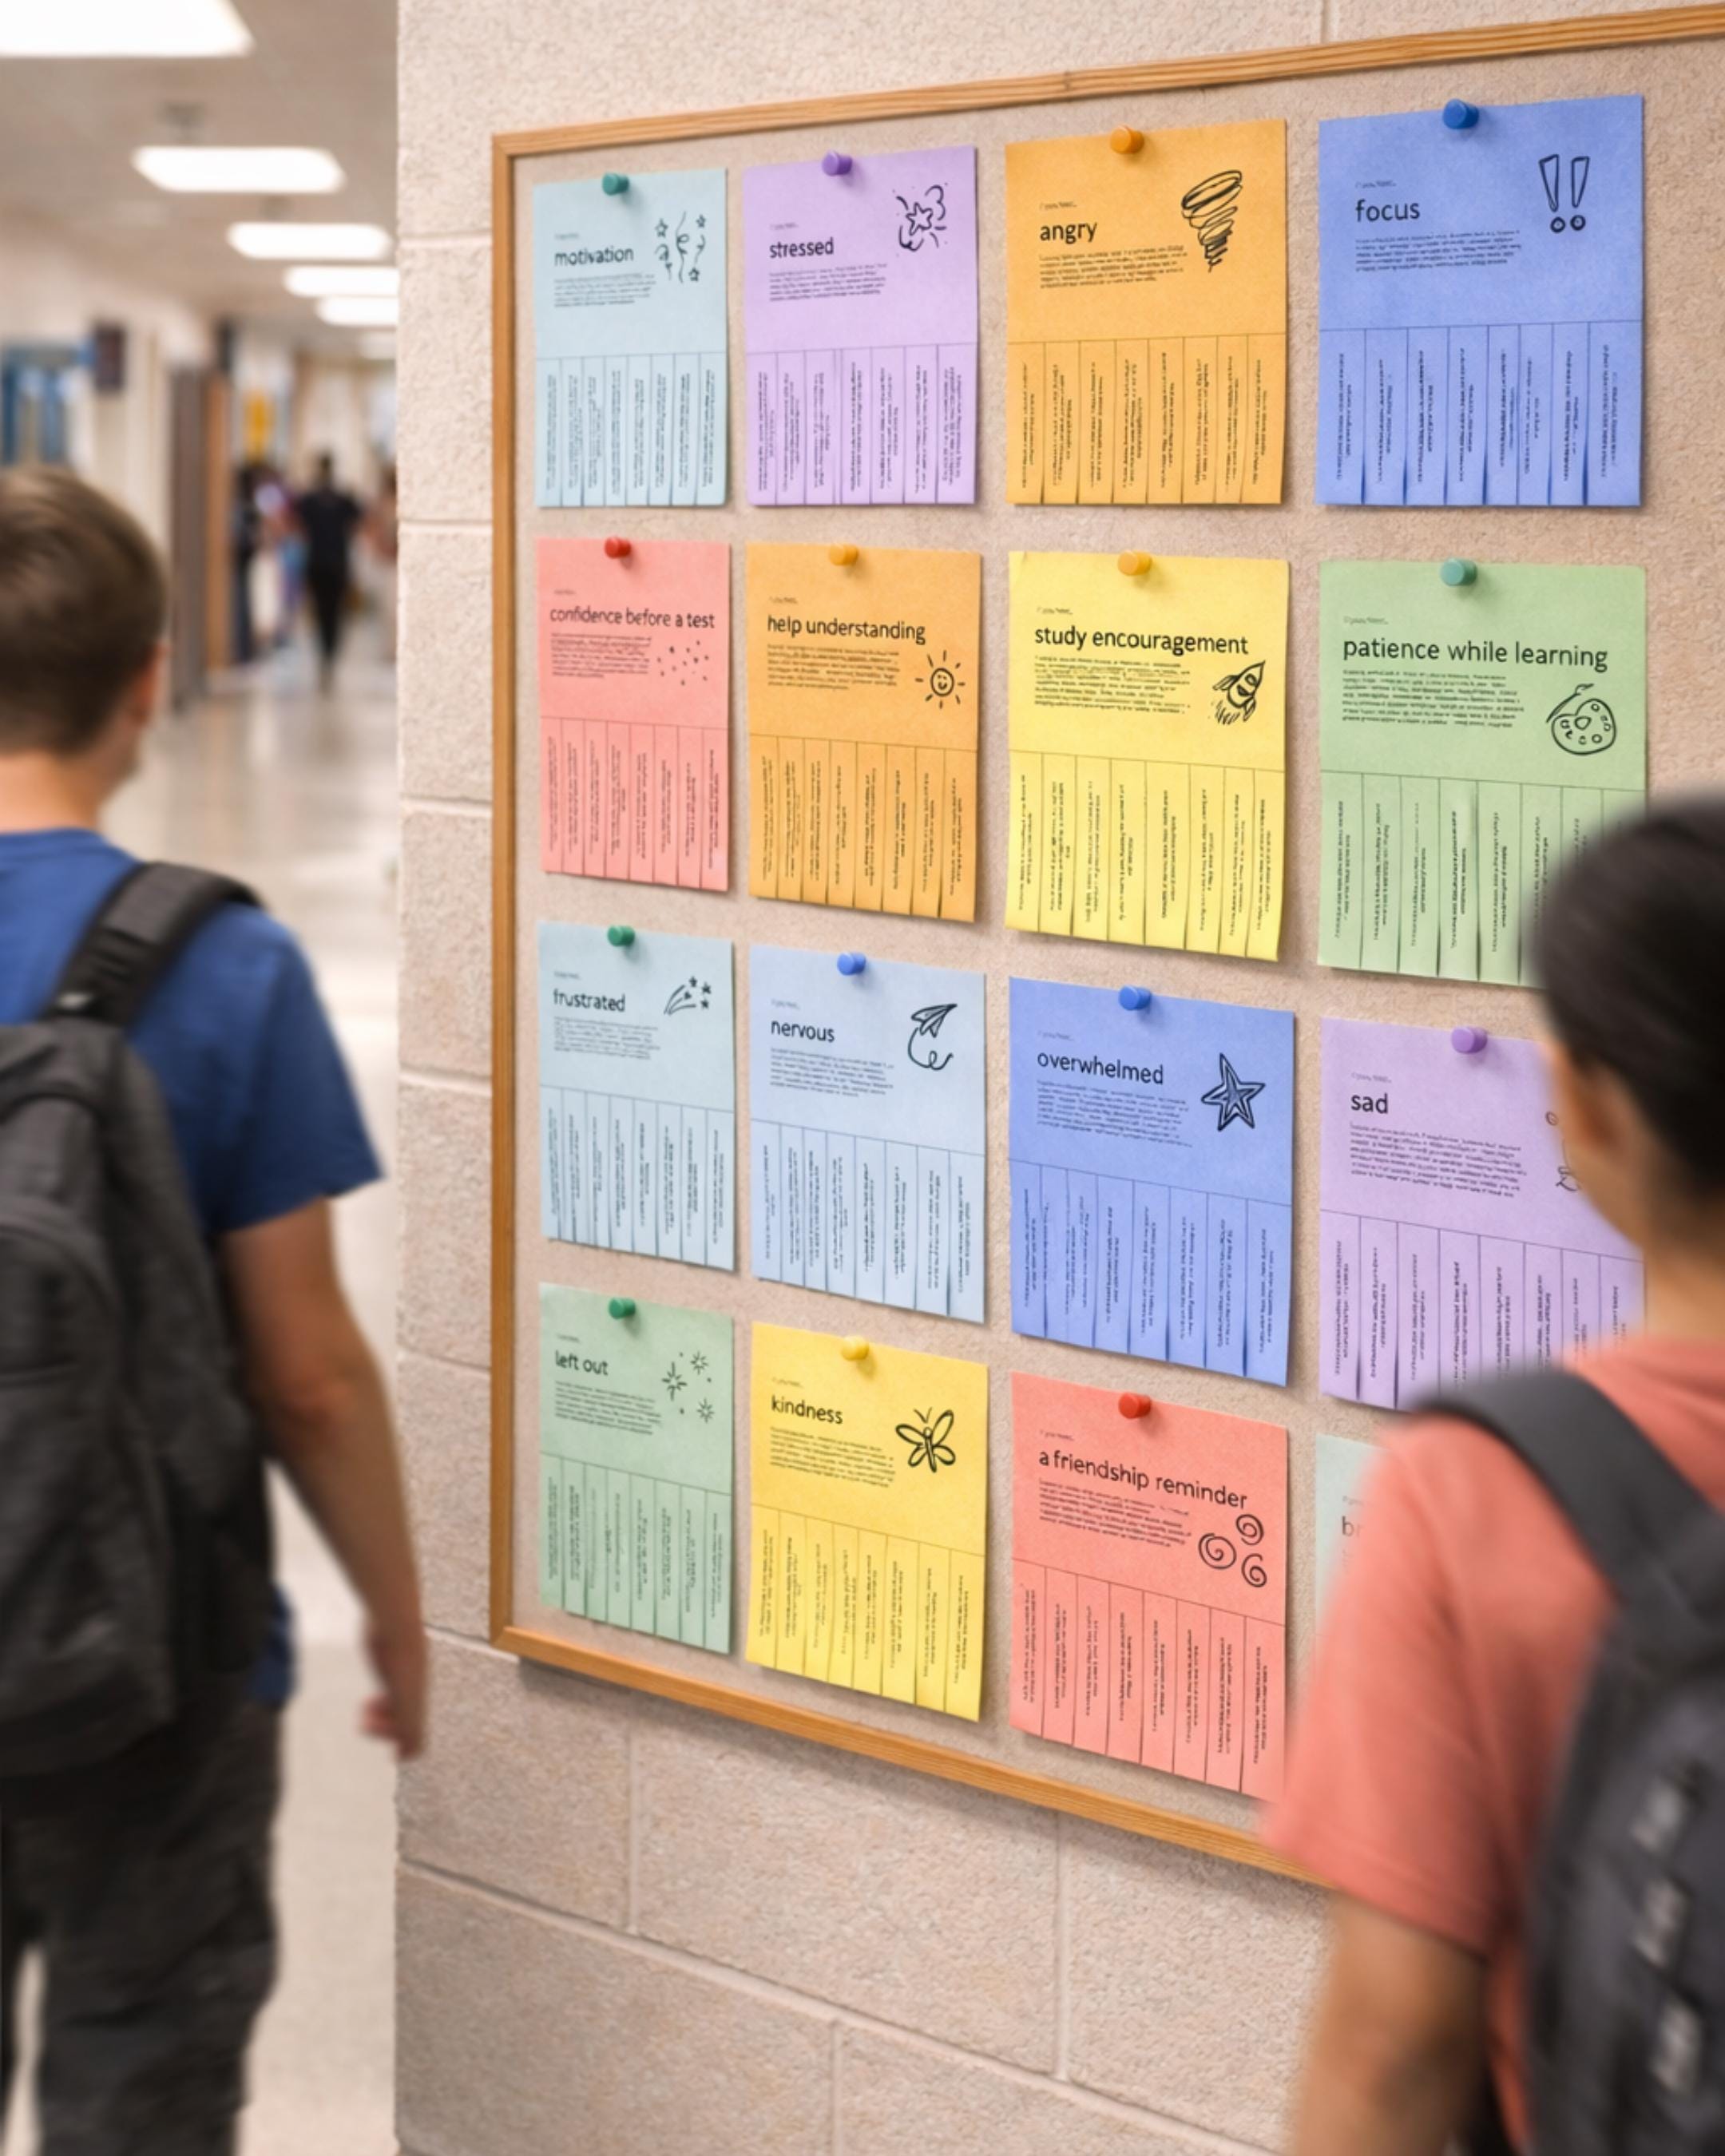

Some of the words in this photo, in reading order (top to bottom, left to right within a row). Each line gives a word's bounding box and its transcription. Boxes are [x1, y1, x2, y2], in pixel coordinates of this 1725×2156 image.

[1354, 198, 1421, 223] focus
[1039, 222, 1098, 245] angry
[554, 247, 634, 267] motivation
[769, 236, 835, 259] stressed
[549, 605, 624, 625] confidence
[625, 608, 672, 628] before
[675, 613, 684, 628] a
[686, 612, 715, 629] test
[767, 614, 803, 639] help
[806, 617, 926, 645] understanding
[1034, 624, 1088, 652] study
[1092, 631, 1249, 657] encouragement
[1343, 637, 1440, 661] patience
[1447, 640, 1508, 663] while
[1515, 640, 1608, 674] learning
[553, 988, 626, 1013] frustrated
[771, 1020, 835, 1043] nervous
[1037, 1052, 1164, 1086] overwhelmed
[1350, 1092, 1389, 1115] sad
[555, 1350, 580, 1371] left
[582, 1358, 609, 1377] out
[771, 1394, 843, 1425] kindness
[1038, 1451, 1049, 1467] a
[1053, 1449, 1150, 1491] friendship
[1156, 1476, 1248, 1509] reminder
